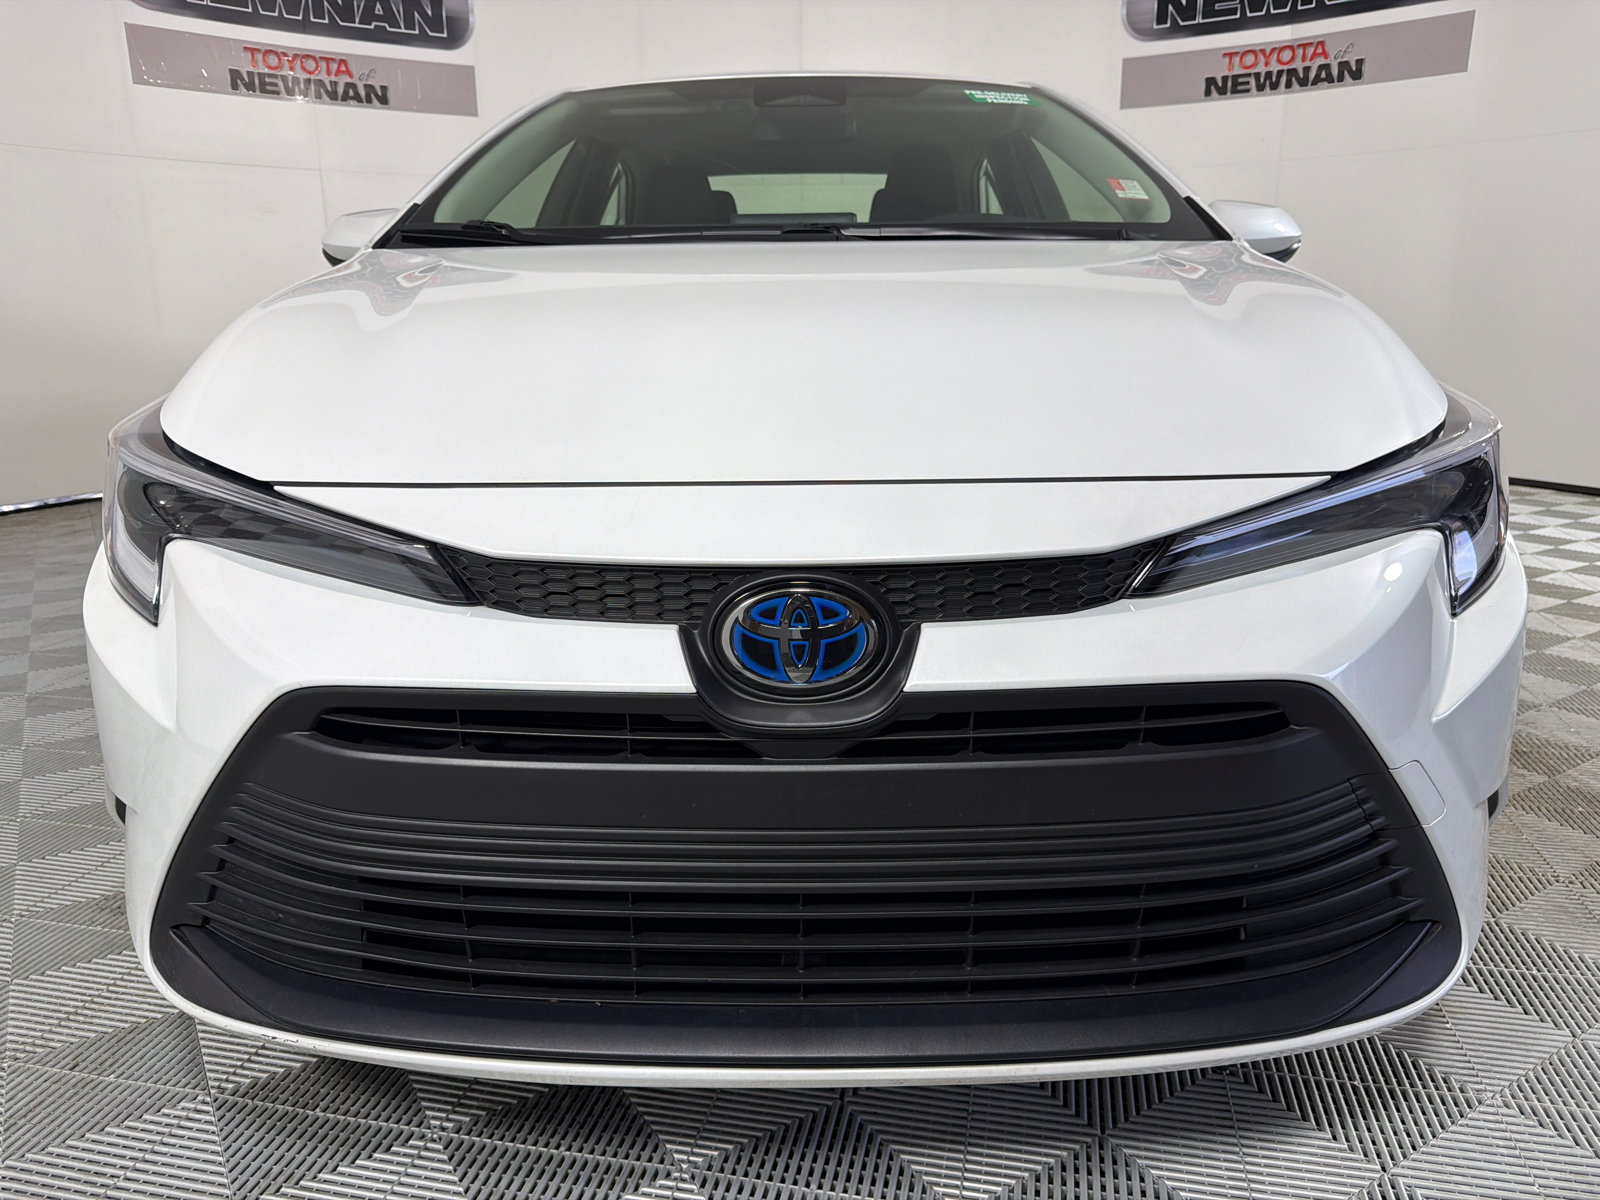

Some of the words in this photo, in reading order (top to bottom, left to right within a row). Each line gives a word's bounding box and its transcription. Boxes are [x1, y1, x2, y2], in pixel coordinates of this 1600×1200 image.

[186, 0, 448, 37] NAN
[243, 46, 354, 80] TOYOTA
[1222, 40, 1330, 71] TOYOTA
[1334, 43, 1353, 60] of
[229, 68, 390, 106] NEWNAN
[1204, 58, 1365, 98] NEWNAN
